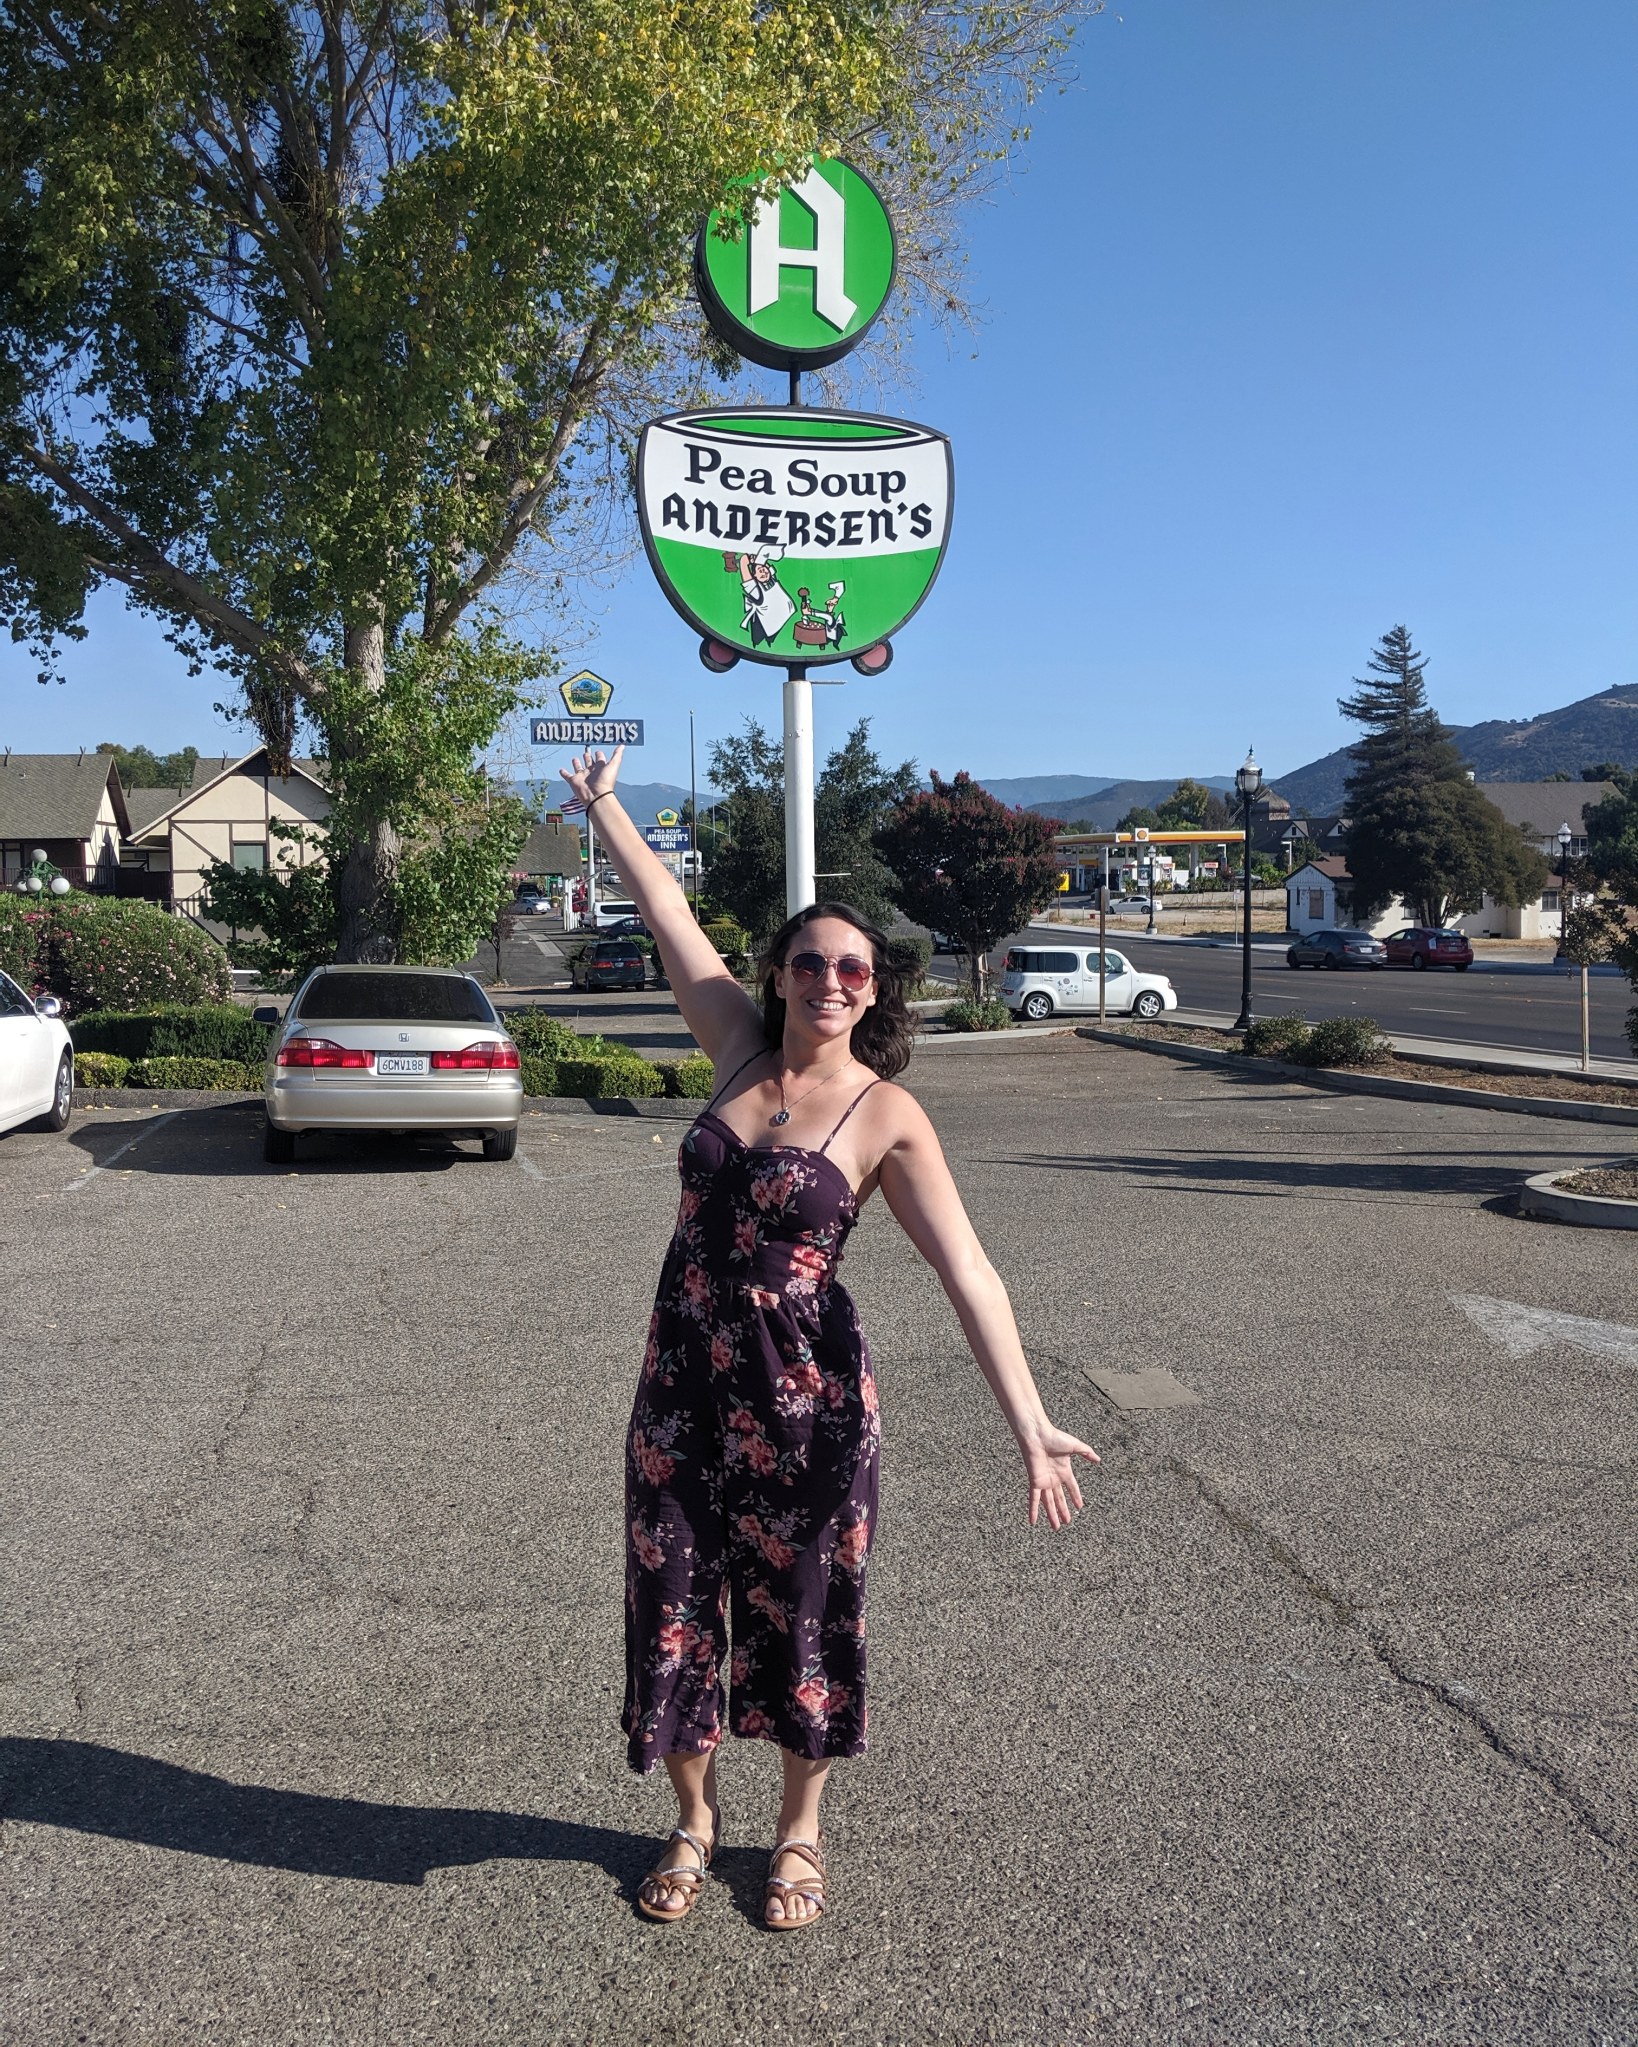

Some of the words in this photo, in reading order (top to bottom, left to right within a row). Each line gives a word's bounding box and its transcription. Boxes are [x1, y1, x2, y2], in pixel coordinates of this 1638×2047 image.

[747, 165, 858, 334] A
[683, 443, 776, 495] Pea
[787, 459, 907, 504] Soup
[662, 492, 933, 548] ANDERSEN'S
[535, 721, 639, 742] ANDERSEN'S
[647, 833, 689, 842] ANDERSEN'S
[660, 841, 676, 849] INN
[382, 1059, 424, 1071] 6CMV188
